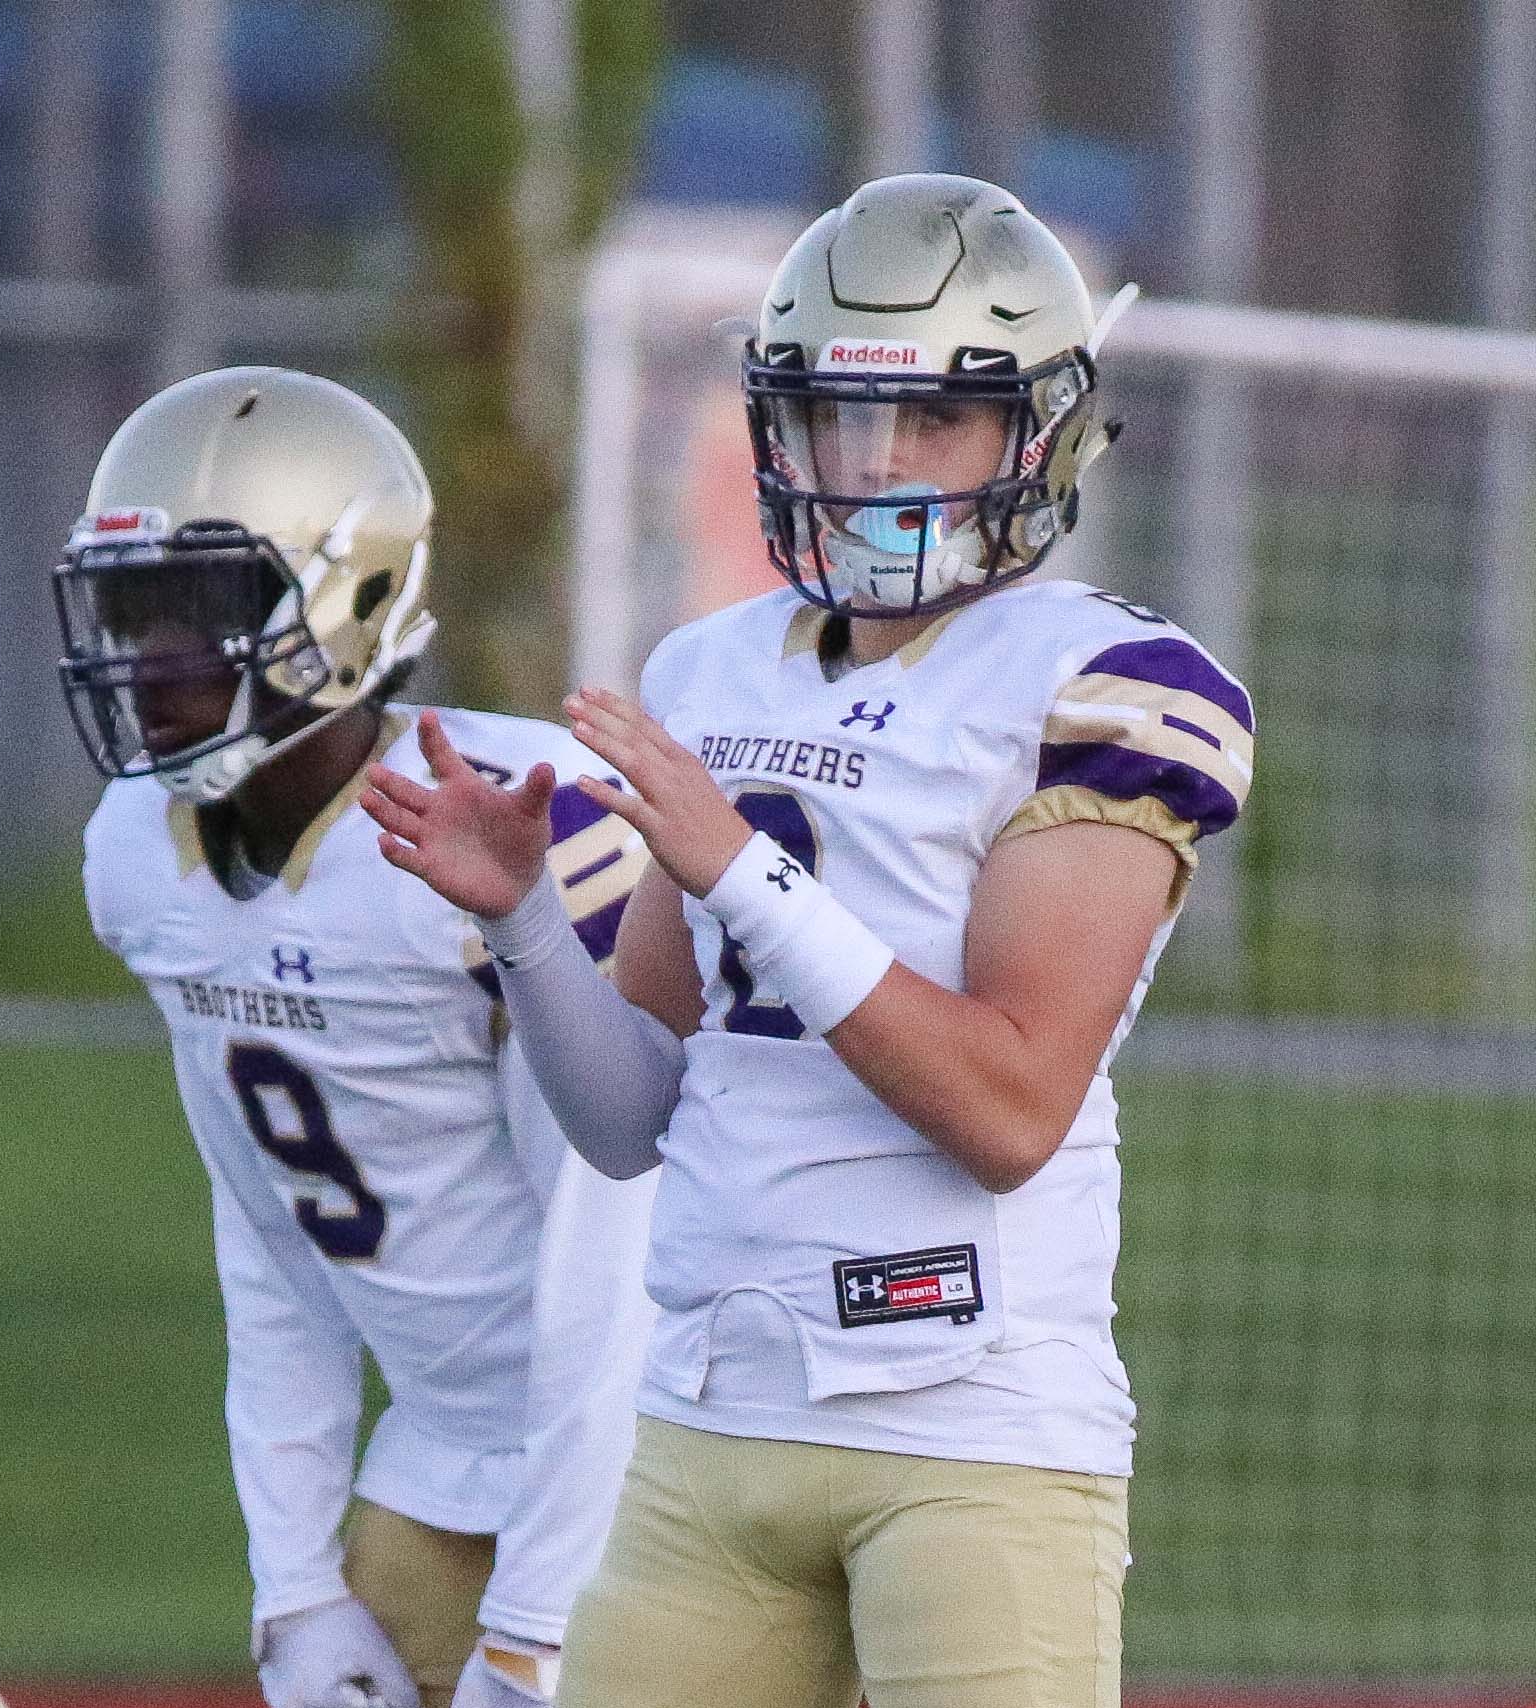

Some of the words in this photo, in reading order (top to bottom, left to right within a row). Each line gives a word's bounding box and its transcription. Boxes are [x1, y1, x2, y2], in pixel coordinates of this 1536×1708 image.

[830, 344, 918, 366] Riddell
[700, 735, 867, 789] BROTHERS
[226, 1040, 388, 1262] 9
